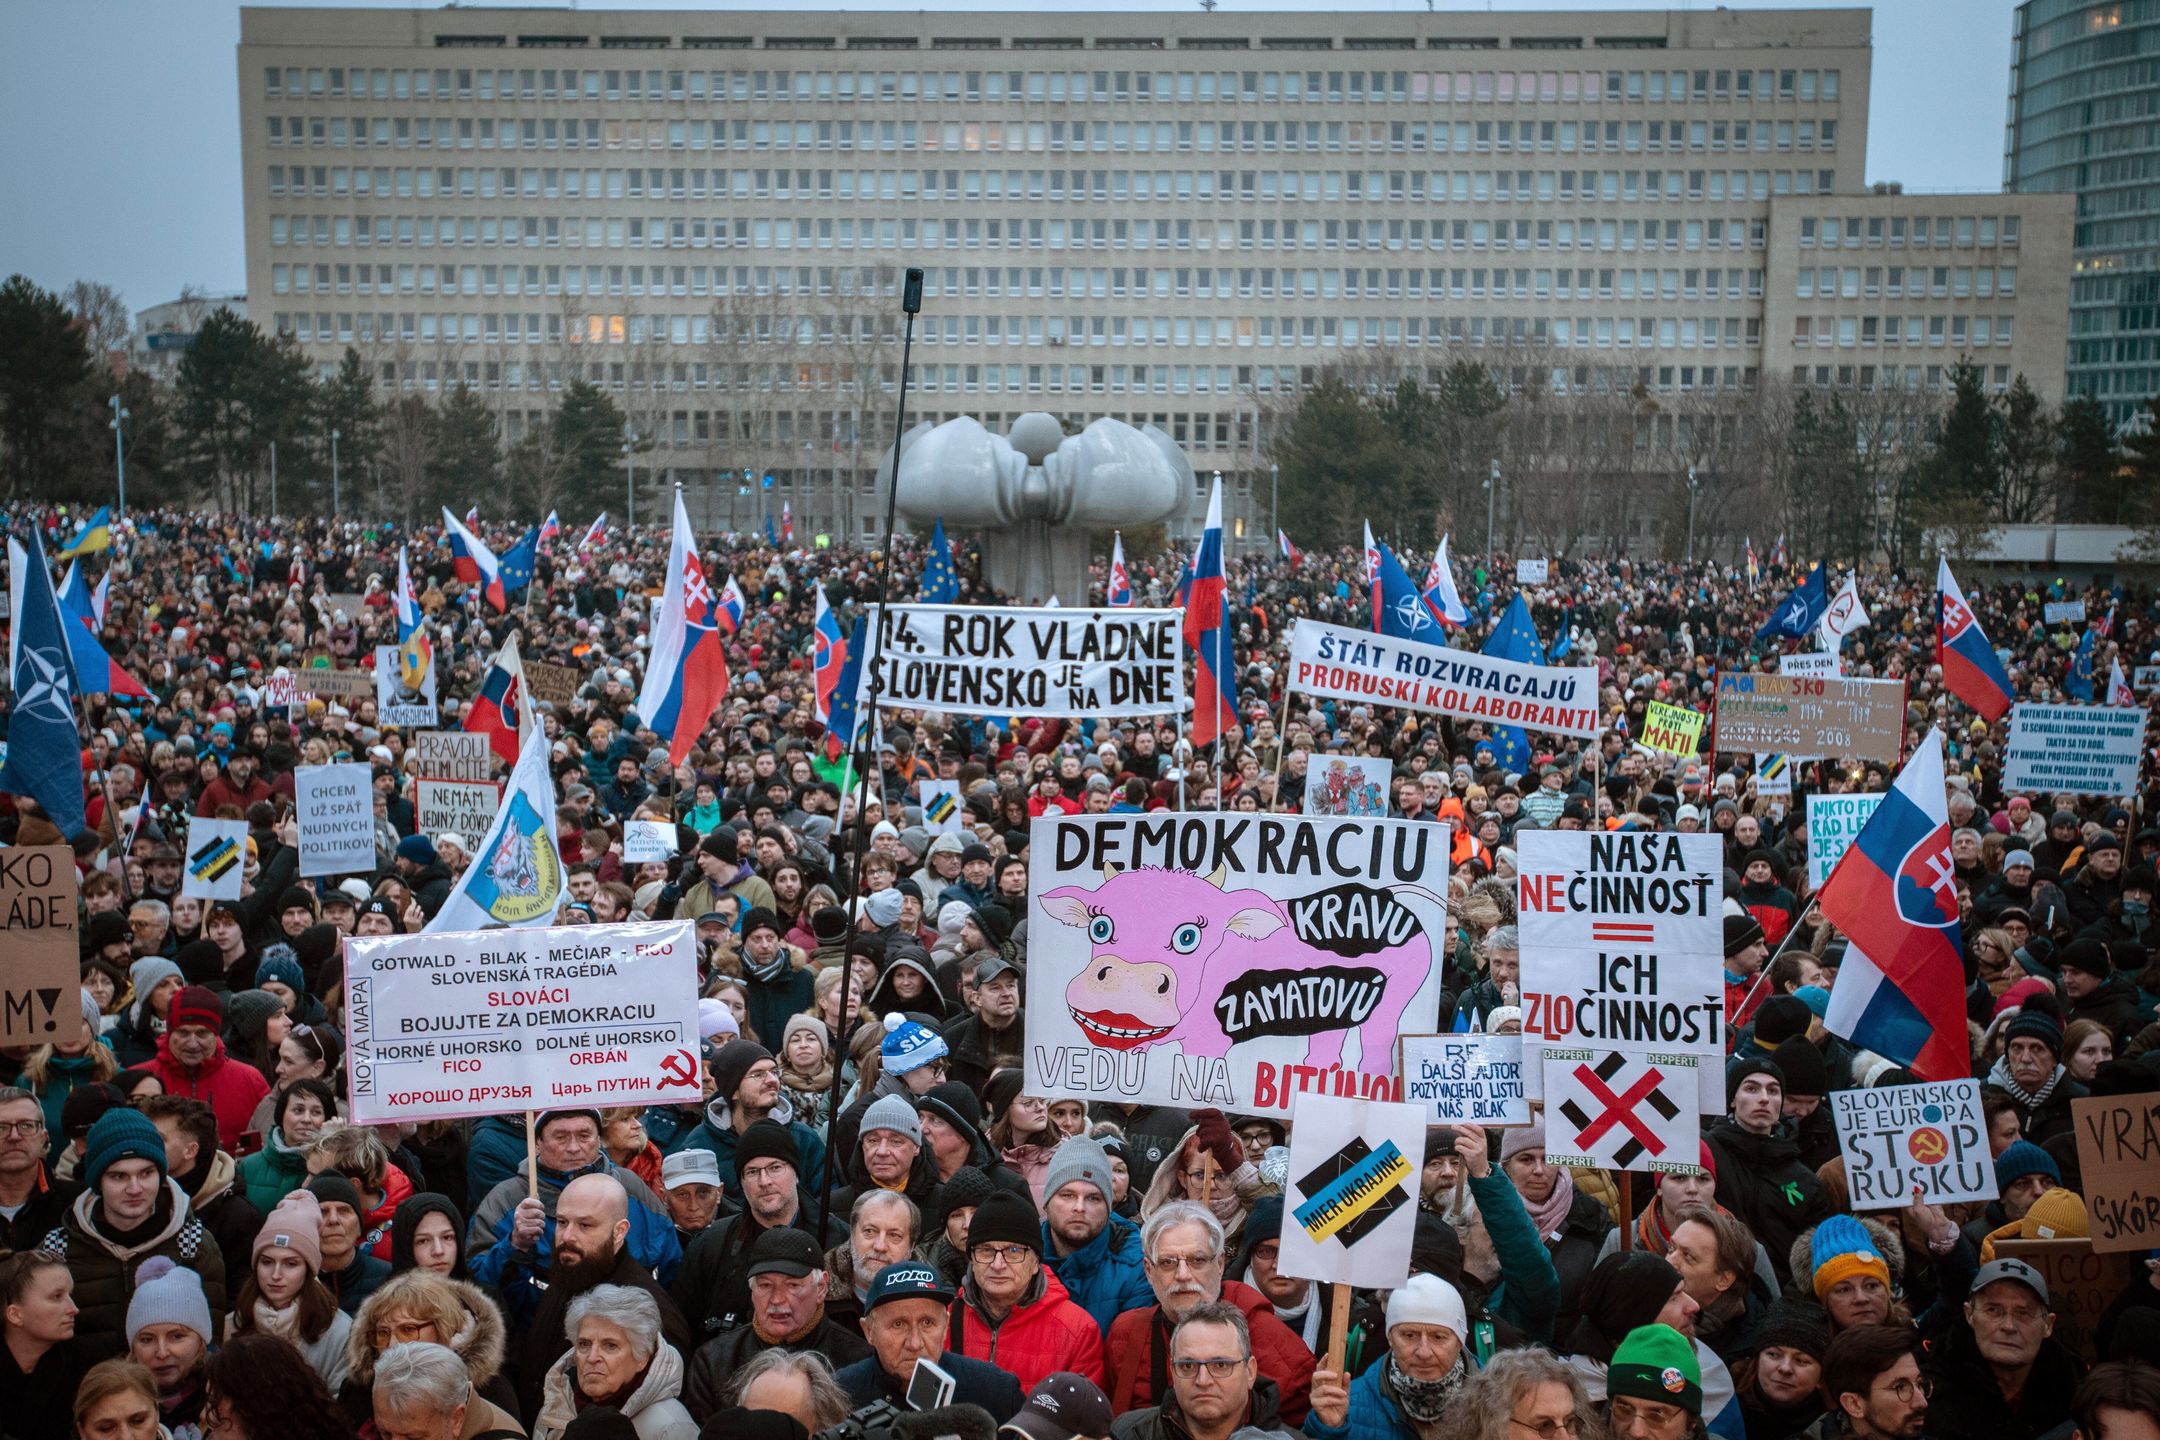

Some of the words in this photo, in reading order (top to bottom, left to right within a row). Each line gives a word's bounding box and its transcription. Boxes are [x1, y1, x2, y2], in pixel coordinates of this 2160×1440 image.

[943, 613, 1016, 659] ROK
[1028, 612, 1176, 662] VLÁDNE
[1317, 631, 1386, 668] ŠTÁT
[1395, 651, 1577, 702] ROZVRACAJÚ
[865, 658, 1047, 708] SLOVENSKO
[1053, 664, 1083, 688] JE
[1069, 687, 1100, 710] NA
[1109, 665, 1175, 705] DNE
[1297, 662, 1421, 704] PRORUSKÍ
[1424, 685, 1597, 732] KOLABORANTI
[419, 735, 484, 759] PRAVDU
[1644, 724, 1692, 753] MAFII
[1816, 729, 1851, 746] 2008
[311, 784, 356, 799] CHCEM
[432, 786, 484, 807] NEMÁM
[311, 802, 327, 817] UŽ
[330, 800, 362, 815] SPÄŤ
[420, 808, 457, 829] JEDINÝ
[1813, 800, 1855, 817] NIKTO
[302, 819, 368, 836] NUDNÝCH
[1812, 815, 1842, 837] RÁD
[301, 838, 373, 854] POLITIKOV!
[1055, 818, 1429, 882] DEMOKRACIU
[1590, 833, 1686, 874] NAŠA
[1520, 870, 1714, 917] NEČINNOSŤ
[0, 892, 73, 931] ÁDE,
[1294, 893, 1415, 944] KRAVU
[371, 954, 456, 971] GOTWALD
[480, 951, 527, 966] BILAK
[548, 945, 612, 962] MEČIAR
[431, 967, 530, 986] SLOVENSKÁ
[1599, 953, 1658, 996] ICH
[352, 980, 369, 1034] MAPA
[487, 986, 571, 1008] SLOVÁCI
[1218, 976, 1386, 1033] ZAMATOVÚ
[400, 1013, 491, 1034] BOJUJTE
[496, 1011, 522, 1029] ZA
[525, 1004, 656, 1027] DEMOKRACIU
[1522, 988, 1724, 1045] ZLOČINNOSŤ
[376, 1044, 436, 1060] HORNÉ
[440, 1039, 523, 1057] UHORSKO
[536, 1033, 591, 1052] DOLNÉ
[596, 1029, 677, 1047] UHORSKO
[1544, 1049, 1593, 1061] DEPPERT!
[351, 1038, 372, 1093] NOVÁ
[442, 1058, 482, 1074] FICO
[569, 1049, 628, 1067] ORBÁN
[1034, 1044, 1148, 1096] VEDÚ
[1170, 1053, 1234, 1106] NA
[1648, 1054, 1699, 1067] DEPPERT!
[388, 1089, 464, 1106] ХОРОШО
[468, 1085, 533, 1103] ДРУЗЬЯ
[551, 1080, 592, 1097] Царь
[596, 1076, 650, 1093] ПУТИН
[1489, 1082, 1524, 1099] LISTU
[1839, 1083, 1972, 1112] SLOVENSKO
[1437, 1099, 1464, 1118] NÁŠ
[1842, 1111, 1869, 1131] JE
[2086, 1105, 2160, 1164] VRA
[1546, 1155, 1595, 1167] DEPPERT!
[1649, 1162, 1700, 1175] DEPPERT!
[1303, 1196, 1344, 1233] MIER
[1341, 1149, 1405, 1208] UKRAJINE
[1851, 1162, 1984, 1201] RUSKU
